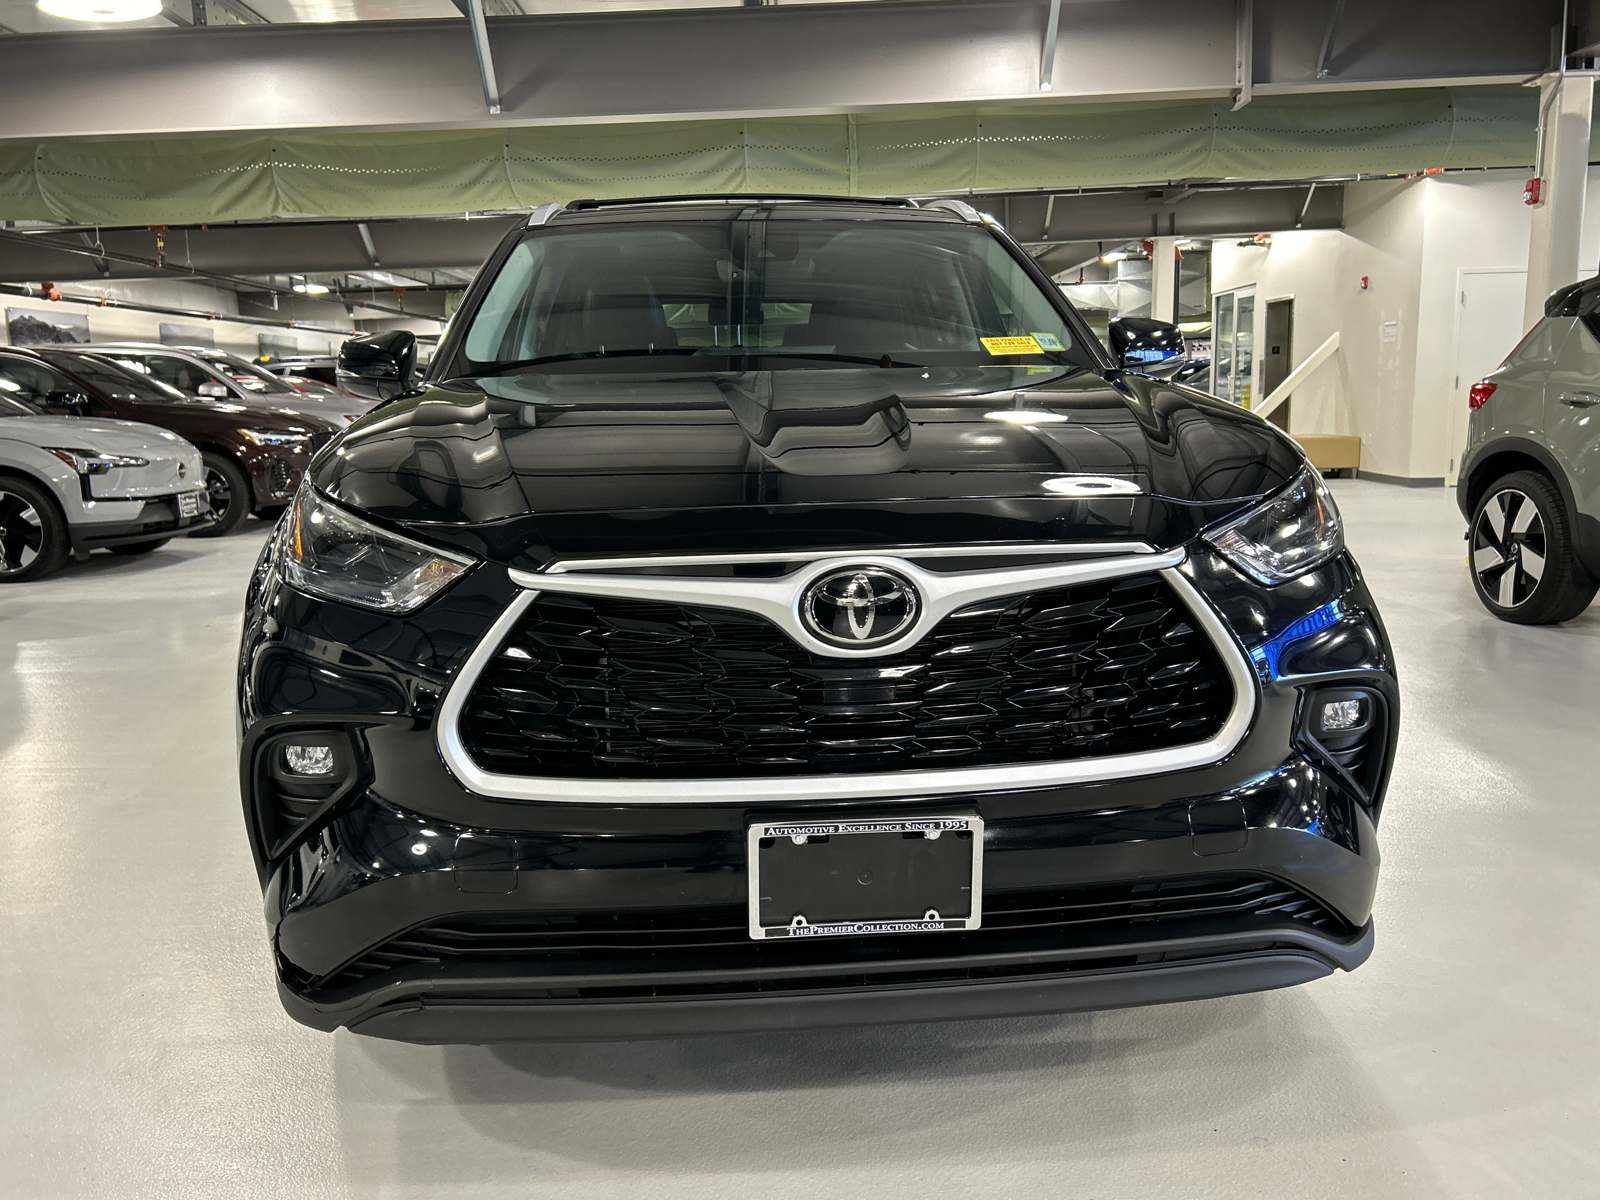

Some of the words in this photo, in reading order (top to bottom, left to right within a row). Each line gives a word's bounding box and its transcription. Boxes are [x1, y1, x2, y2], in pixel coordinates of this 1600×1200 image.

[766, 826, 835, 836] AUTOMOTIVE
[838, 824, 902, 833] EXCELLENCE
[904, 822, 936, 831] SINCE
[939, 820, 968, 830] 1995
